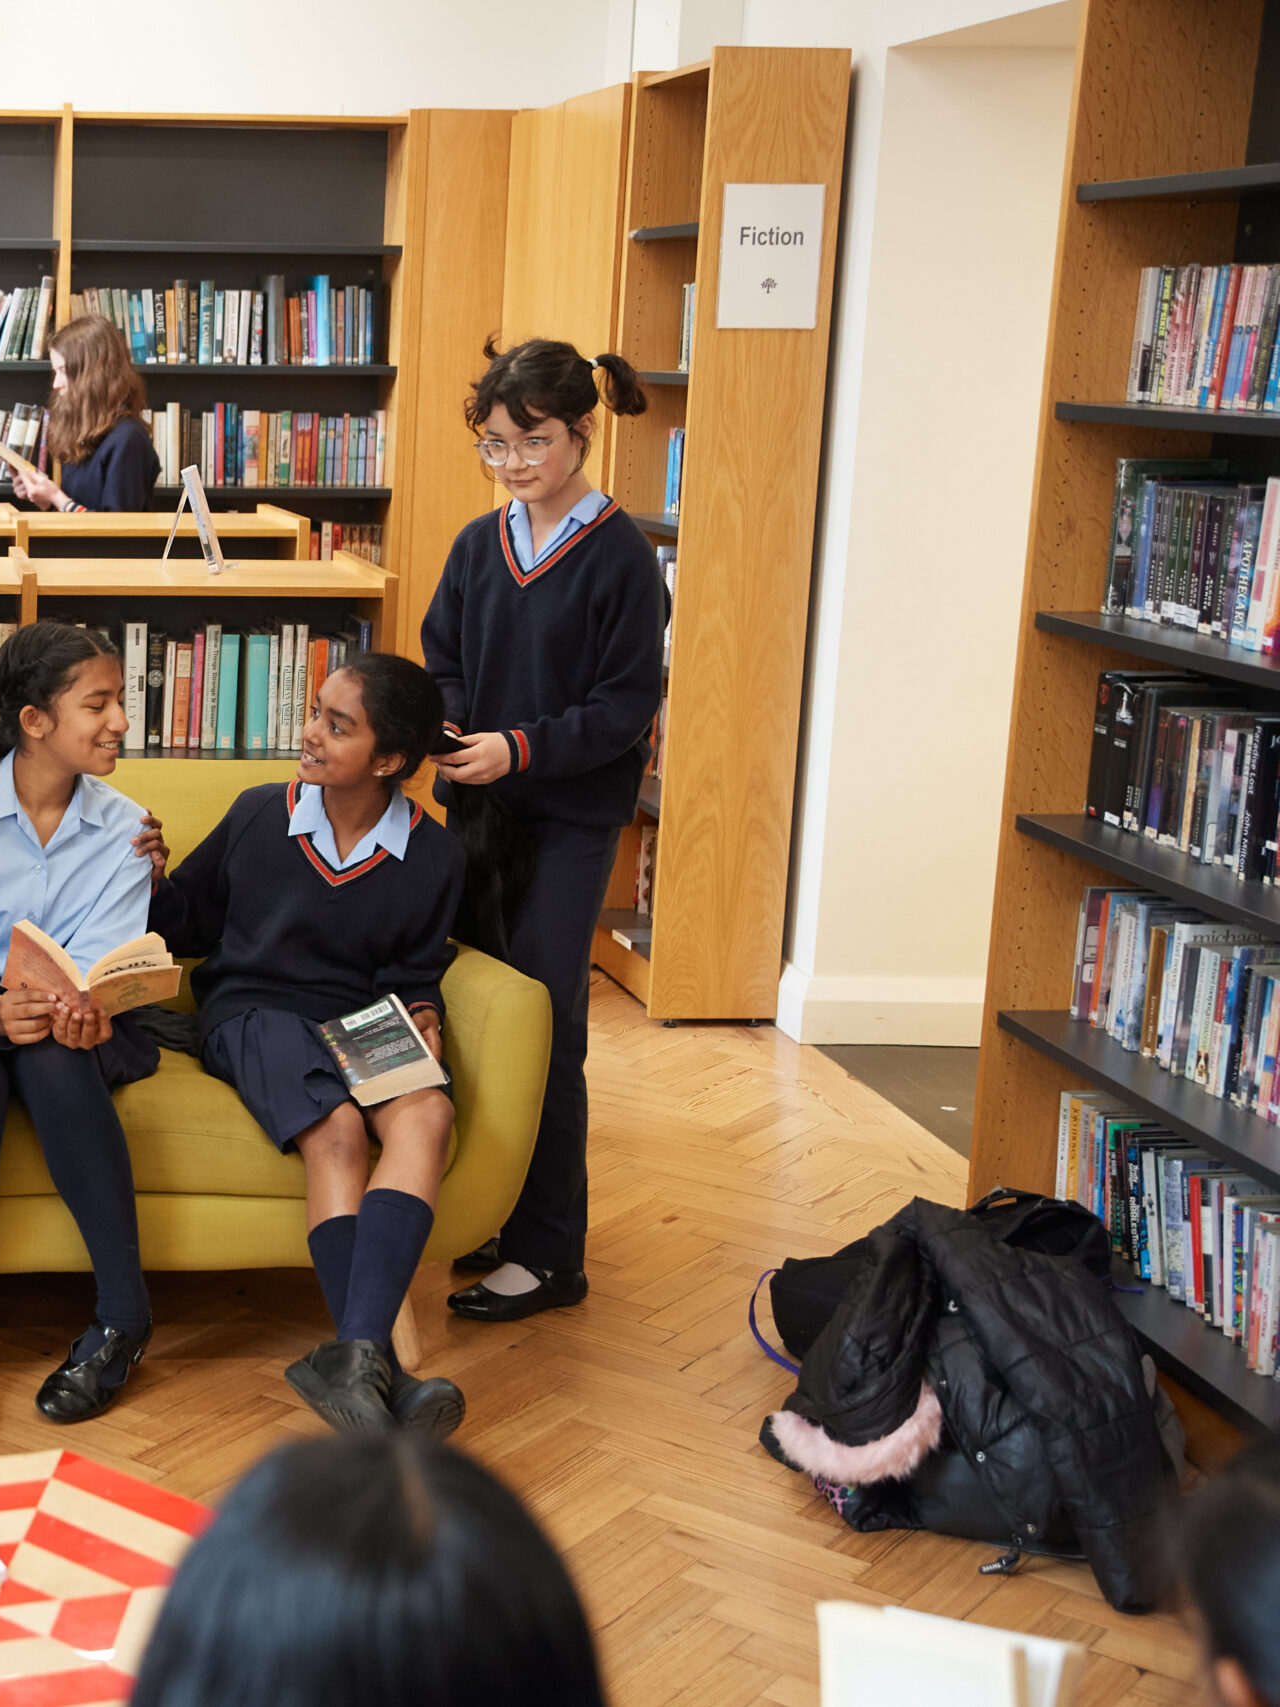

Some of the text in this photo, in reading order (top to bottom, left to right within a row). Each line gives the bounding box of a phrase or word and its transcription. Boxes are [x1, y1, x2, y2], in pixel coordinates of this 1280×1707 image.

[739, 226, 804, 246] Fiction
[155, 294, 165, 334] le CARRÉ
[1234, 541, 1253, 627] APOTHECARY
[126, 666, 139, 721] FAMILY
[284, 665, 292, 699] GUARDIAN
[298, 665, 306, 699] GUARDIAN
[1247, 726, 1262, 794] Paradise Lost
[1239, 810, 1252, 872] John Milton
[1193, 929, 1262, 944] michael
[1128, 1197, 1139, 1258] RIBBLESTROP
[1261, 1293, 1269, 1338] paradise
